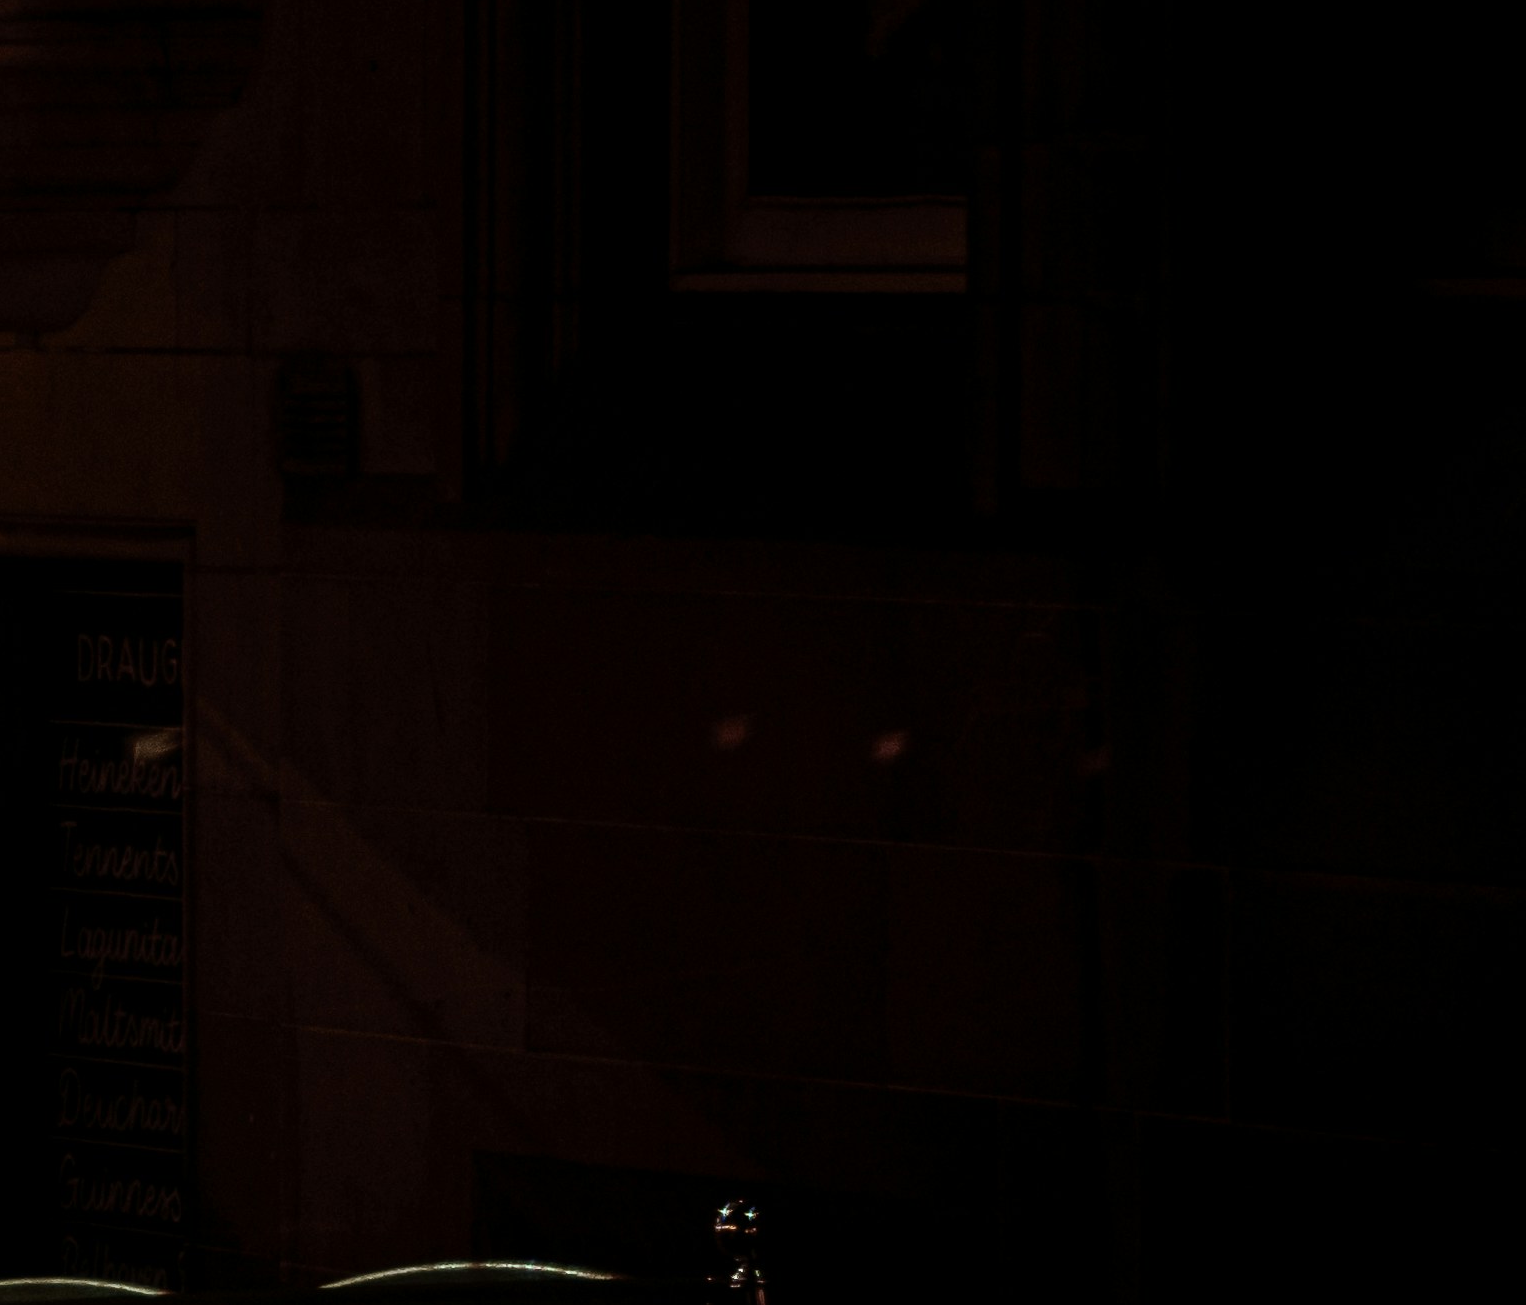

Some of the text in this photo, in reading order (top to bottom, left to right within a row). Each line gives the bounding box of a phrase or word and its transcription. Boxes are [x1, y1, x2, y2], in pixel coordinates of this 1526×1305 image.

[58, 734, 183, 801] Heineken
[61, 820, 180, 887] Tennents
[58, 1150, 183, 1224] Guinness
